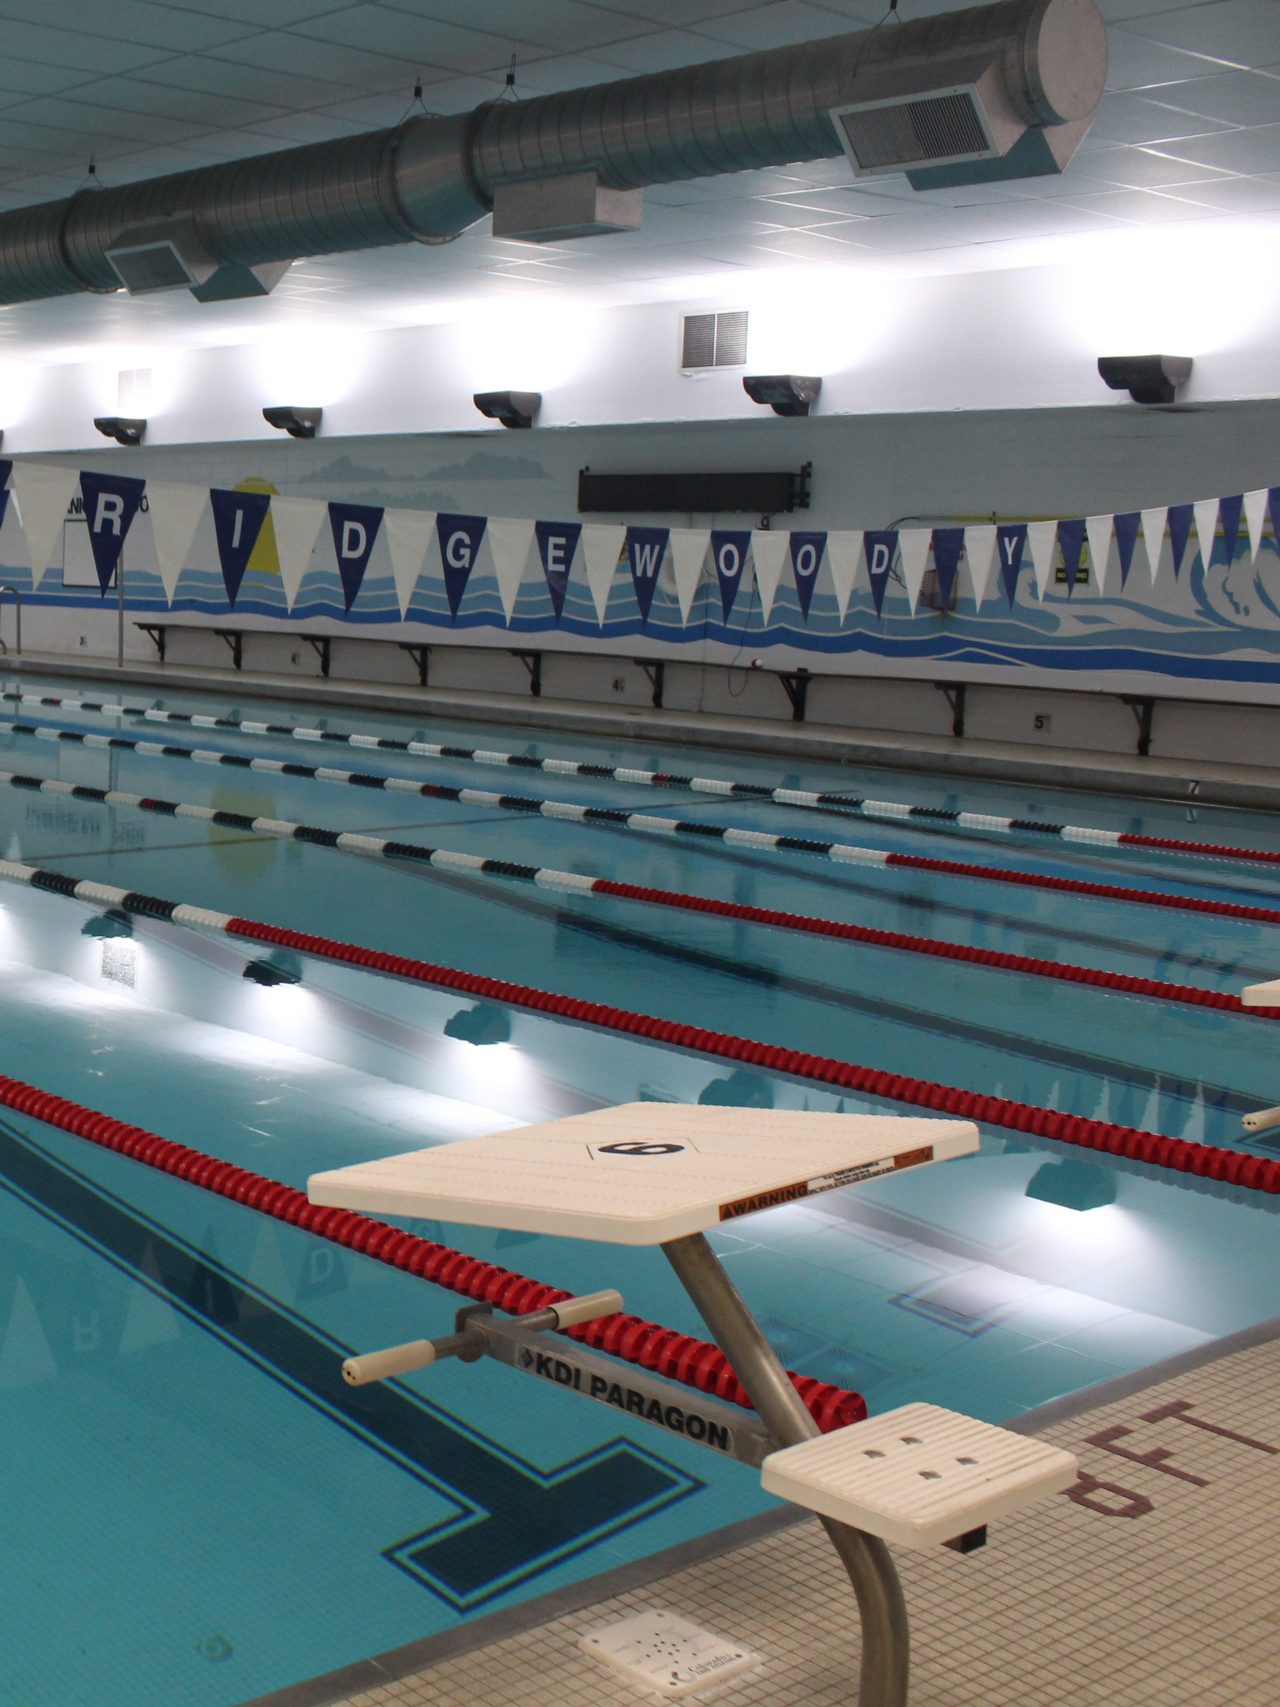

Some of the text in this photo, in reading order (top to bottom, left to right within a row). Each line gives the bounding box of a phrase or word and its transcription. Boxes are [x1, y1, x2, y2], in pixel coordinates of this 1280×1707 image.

[1003, 536, 1019, 566] Y
[1190, 780, 1200, 795] 7
[732, 1183, 809, 1217] WARNING
[535, 1352, 730, 1451] KDI PARAGON
